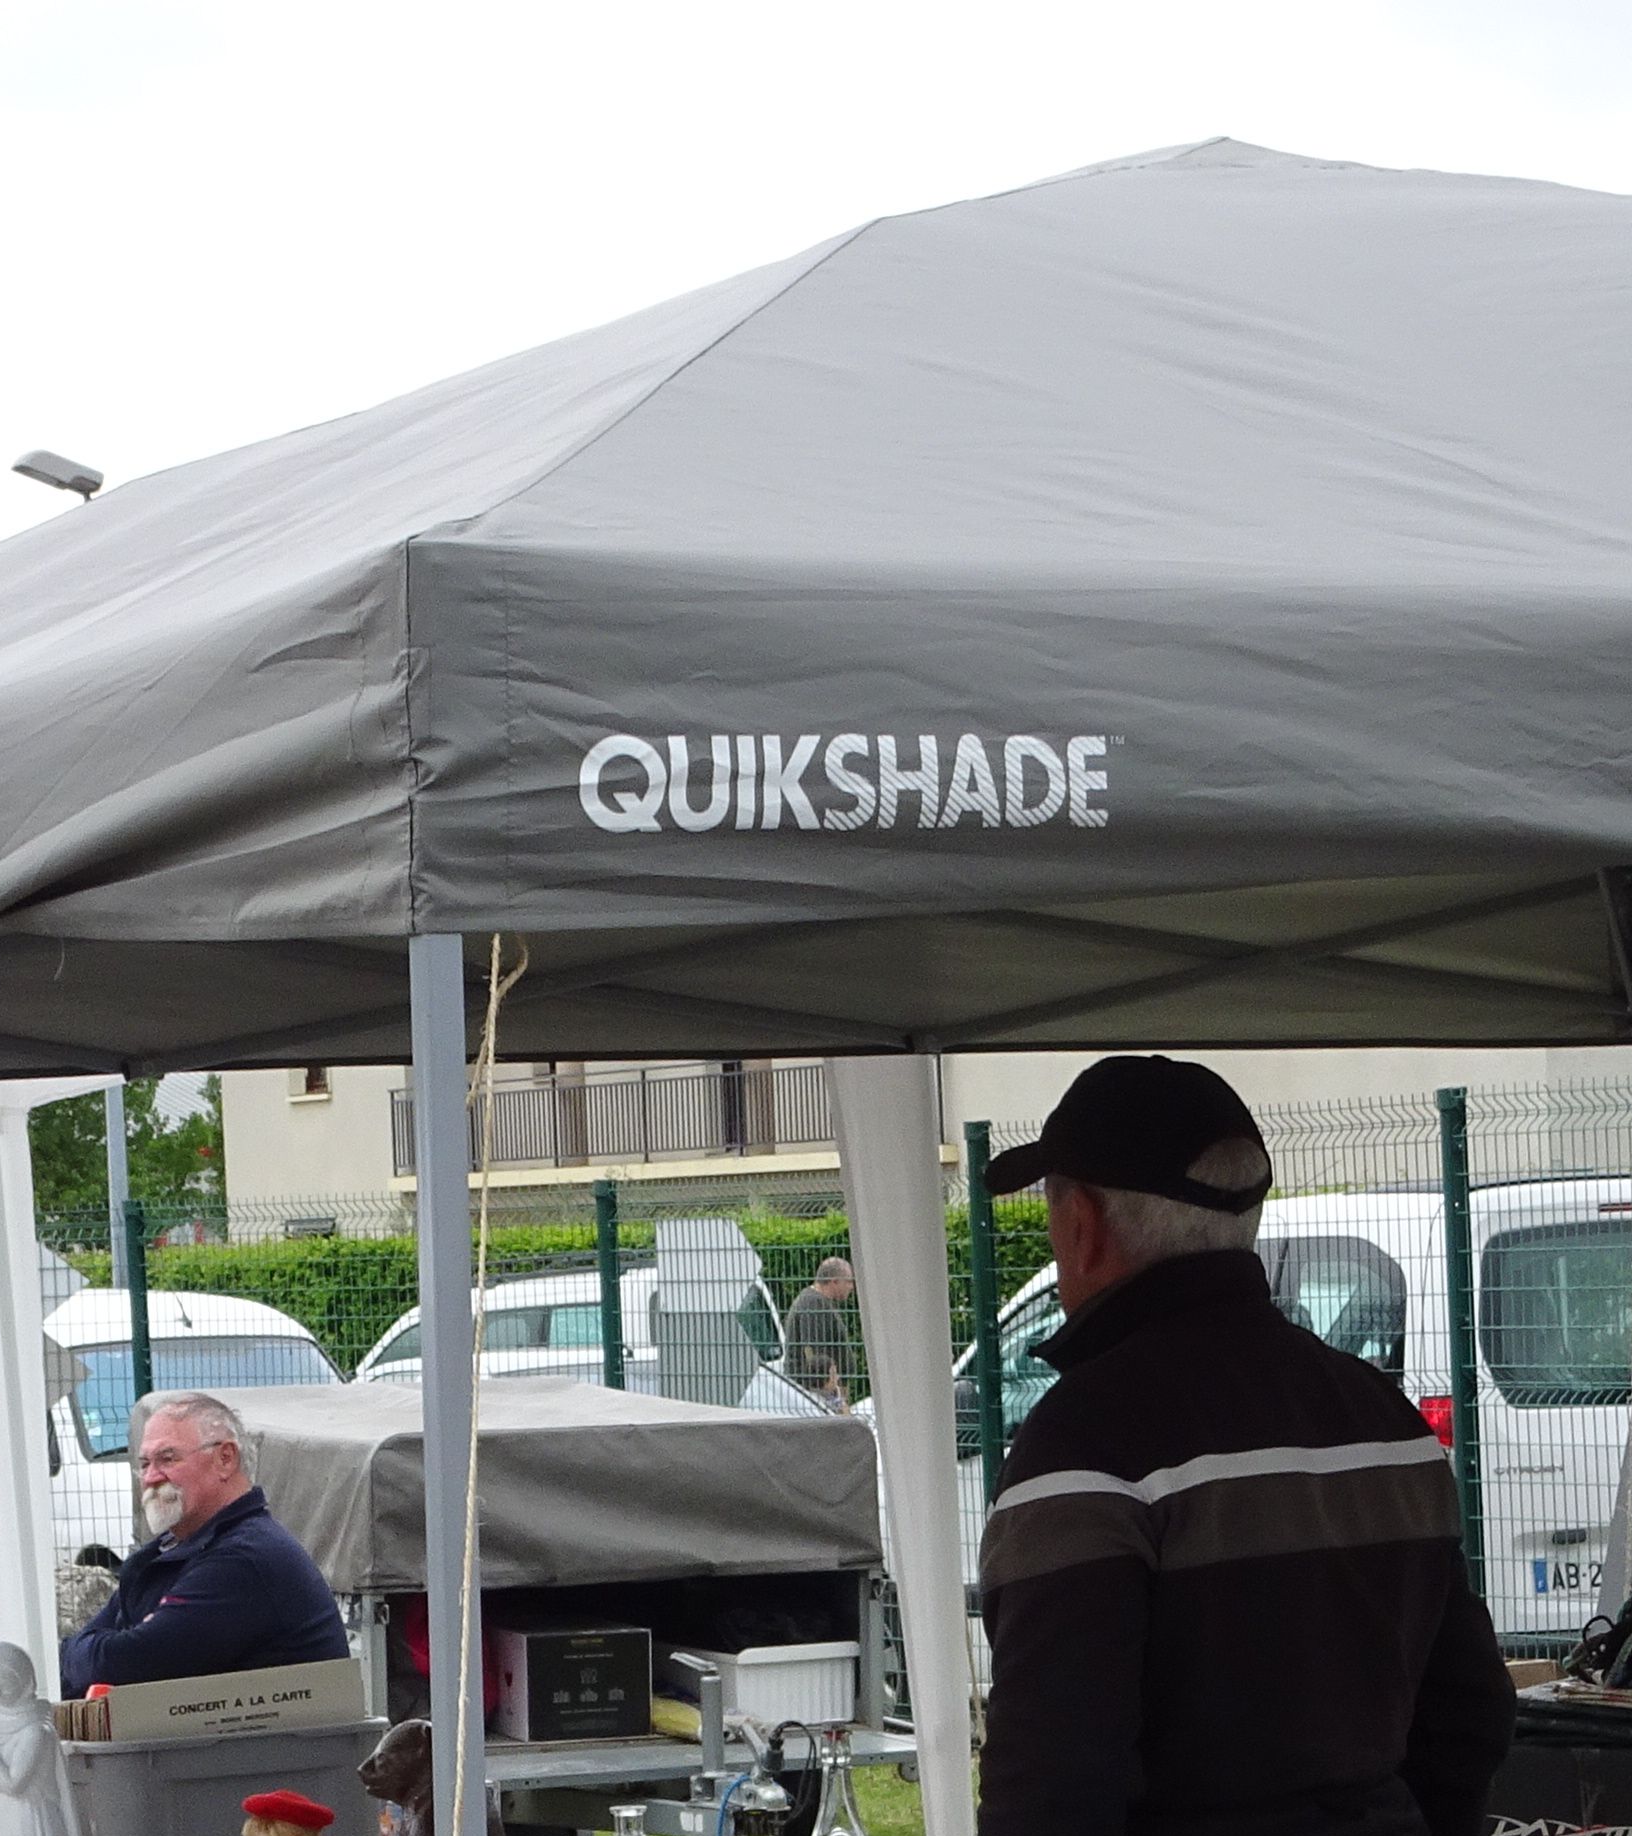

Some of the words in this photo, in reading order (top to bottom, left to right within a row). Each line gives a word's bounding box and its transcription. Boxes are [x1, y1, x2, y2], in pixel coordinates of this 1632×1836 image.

[577, 733, 1109, 833] QUIKSHADE
[169, 1699, 228, 1716] CONCERT
[234, 1698, 244, 1708] A
[250, 1696, 265, 1706] LA
[272, 1689, 312, 1703] CARTE
